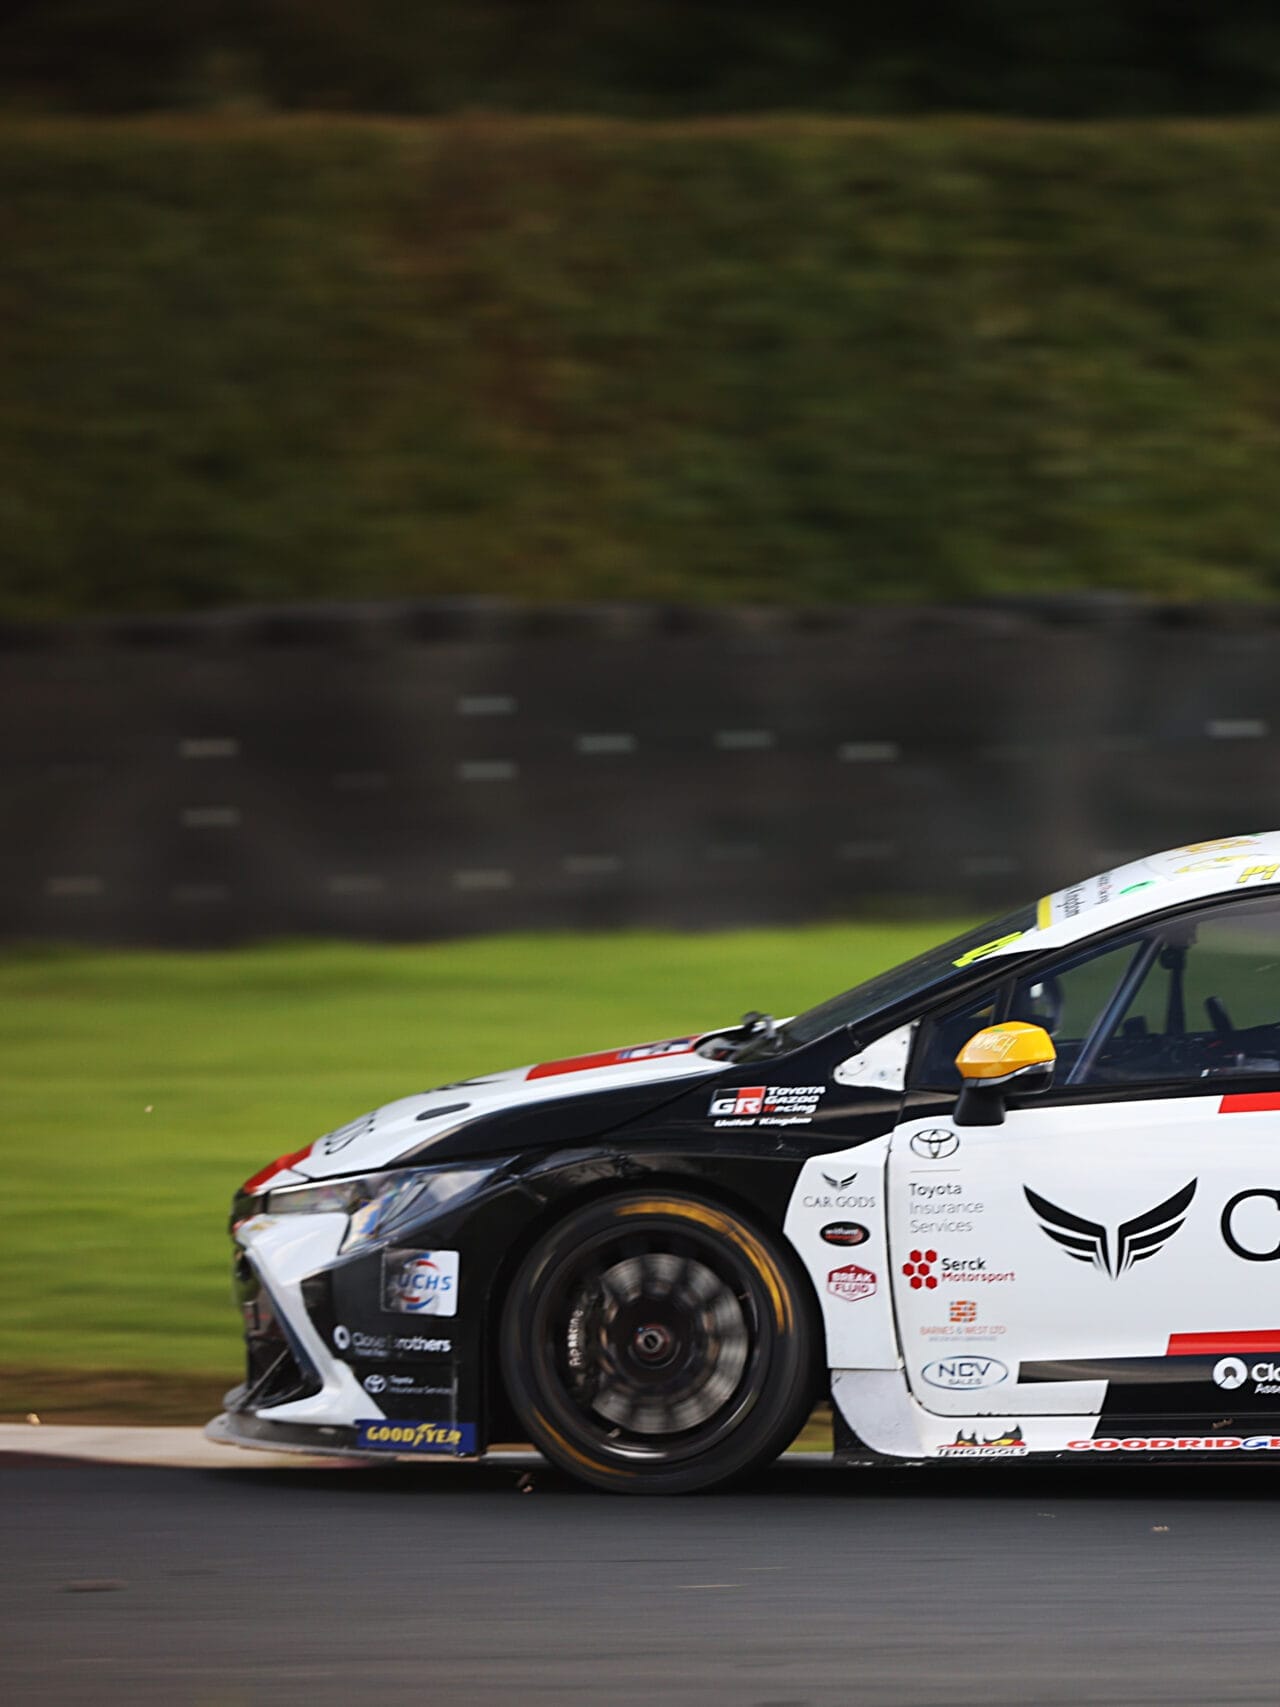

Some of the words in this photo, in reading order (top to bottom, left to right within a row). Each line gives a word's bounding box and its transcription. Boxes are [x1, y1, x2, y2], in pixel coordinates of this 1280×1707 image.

[766, 1086, 826, 1096] TOYOTA
[710, 1097, 761, 1115] GR
[764, 1096, 819, 1104] GAZOO
[763, 1104, 816, 1114] Racing
[714, 1118, 756, 1127] United
[759, 1117, 812, 1126] Kingdom
[909, 1183, 962, 1199] Toyota
[803, 1196, 833, 1208] CAR
[836, 1196, 876, 1208] GODS
[909, 1202, 984, 1214] Insurance
[910, 1219, 973, 1233] Services
[942, 1257, 986, 1271] Serck
[395, 1274, 452, 1291] UCHS
[831, 1272, 872, 1281] BREAK
[942, 1272, 1015, 1283] Motorsport
[835, 1283, 869, 1293] FLUID
[939, 1362, 991, 1377] NCV
